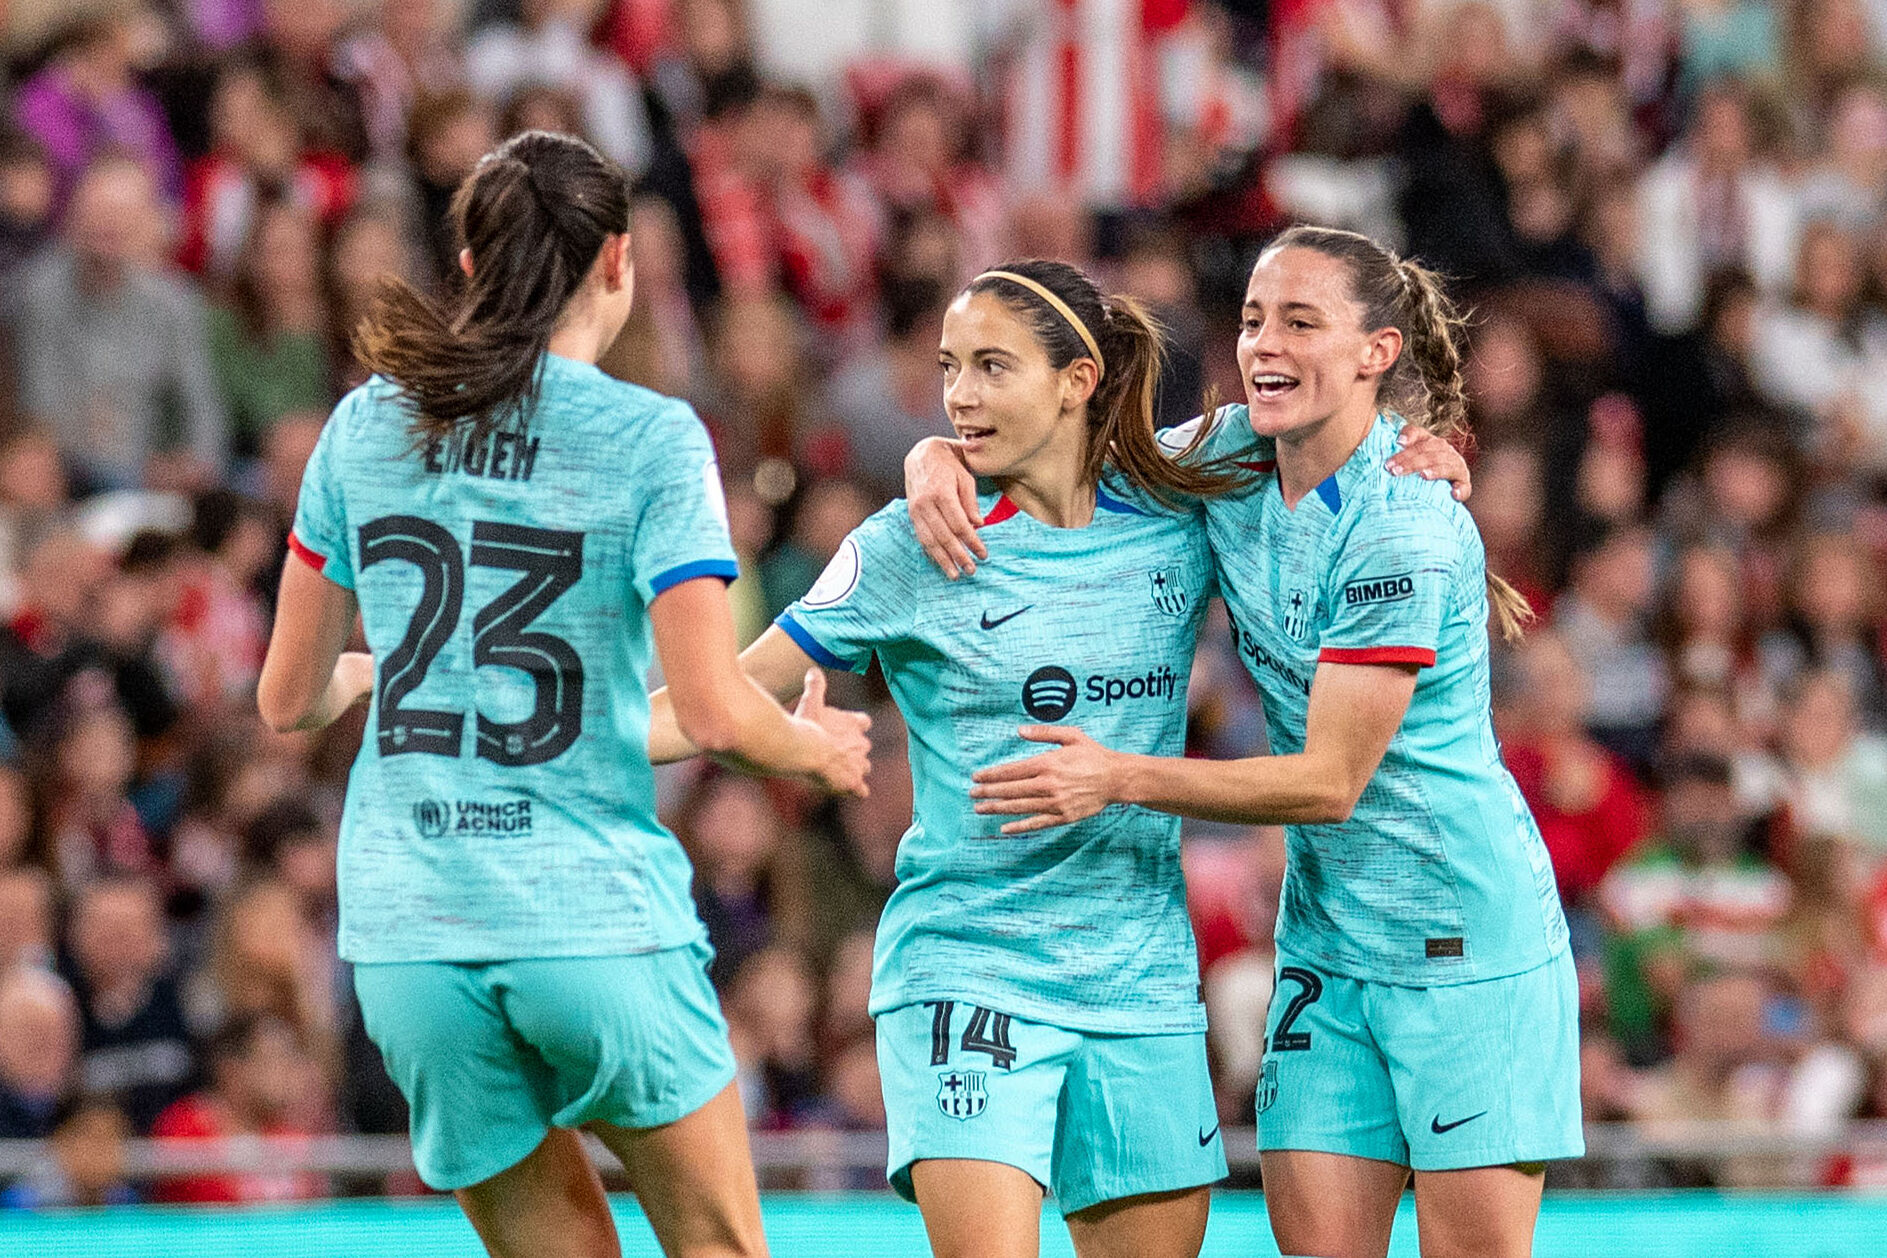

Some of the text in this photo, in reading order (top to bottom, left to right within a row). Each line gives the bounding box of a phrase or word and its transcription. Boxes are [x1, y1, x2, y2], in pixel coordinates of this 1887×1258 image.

[1345, 576, 1413, 605] BIMBO
[358, 515, 585, 767] 23
[1086, 666, 1177, 706] Spotify
[456, 800, 532, 818] UNHCR
[456, 816, 533, 832] ACNUR
[1263, 966, 1323, 1053] 2
[924, 1001, 1017, 1073] 14
